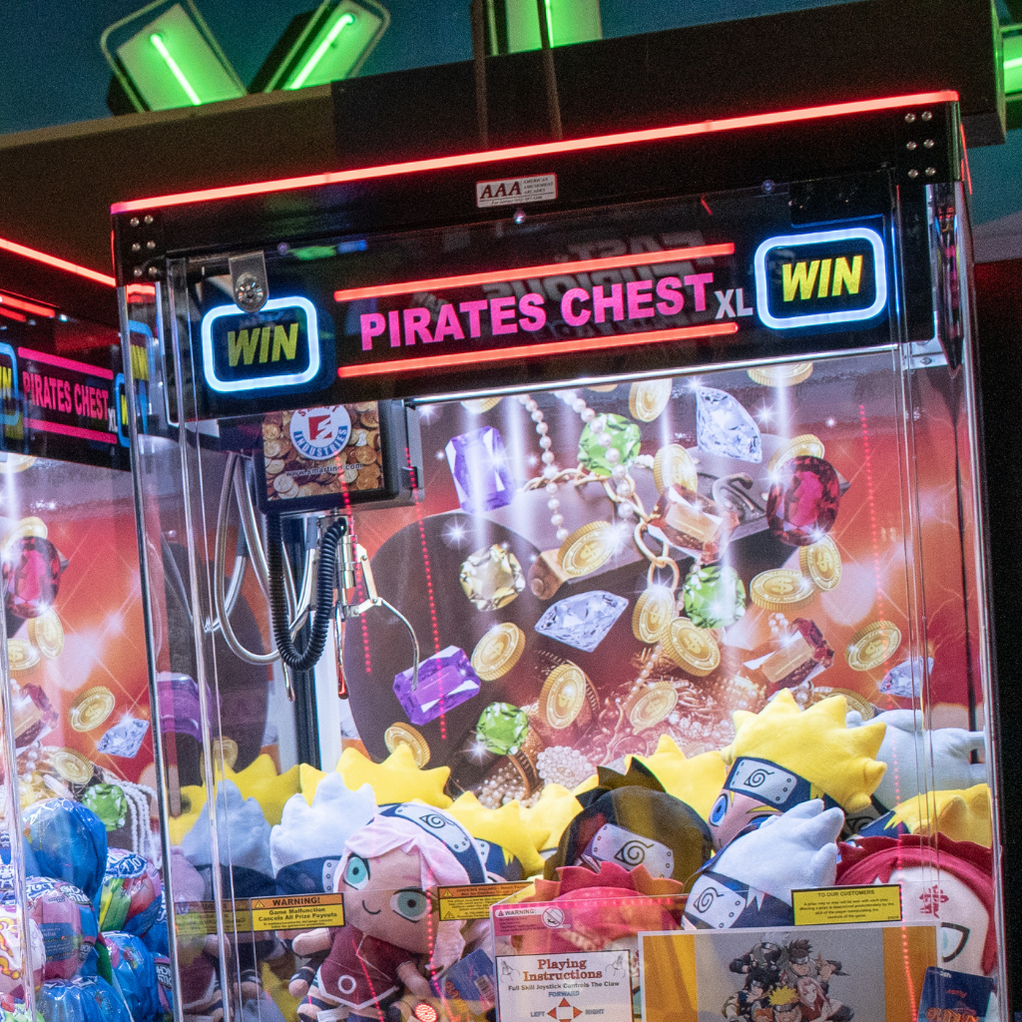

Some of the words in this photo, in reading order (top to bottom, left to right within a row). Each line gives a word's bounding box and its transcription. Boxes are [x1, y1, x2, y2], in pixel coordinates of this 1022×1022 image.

[480, 181, 521, 199] AAA
[782, 255, 864, 302] WIN
[360, 292, 546, 351] PIRATES
[561, 272, 715, 325] CHEST
[715, 288, 754, 320] XL
[228, 322, 299, 367] WIN
[22, 370, 72, 412] PIRATES
[73, 384, 110, 421] CHEST
[293, 425, 348, 457] INDUSTRIES
[272, 897, 321, 906] WARNING!
[312, 911, 338, 919] Payouts
[523, 969, 603, 981] Instructions
[538, 958, 587, 970] Playing
